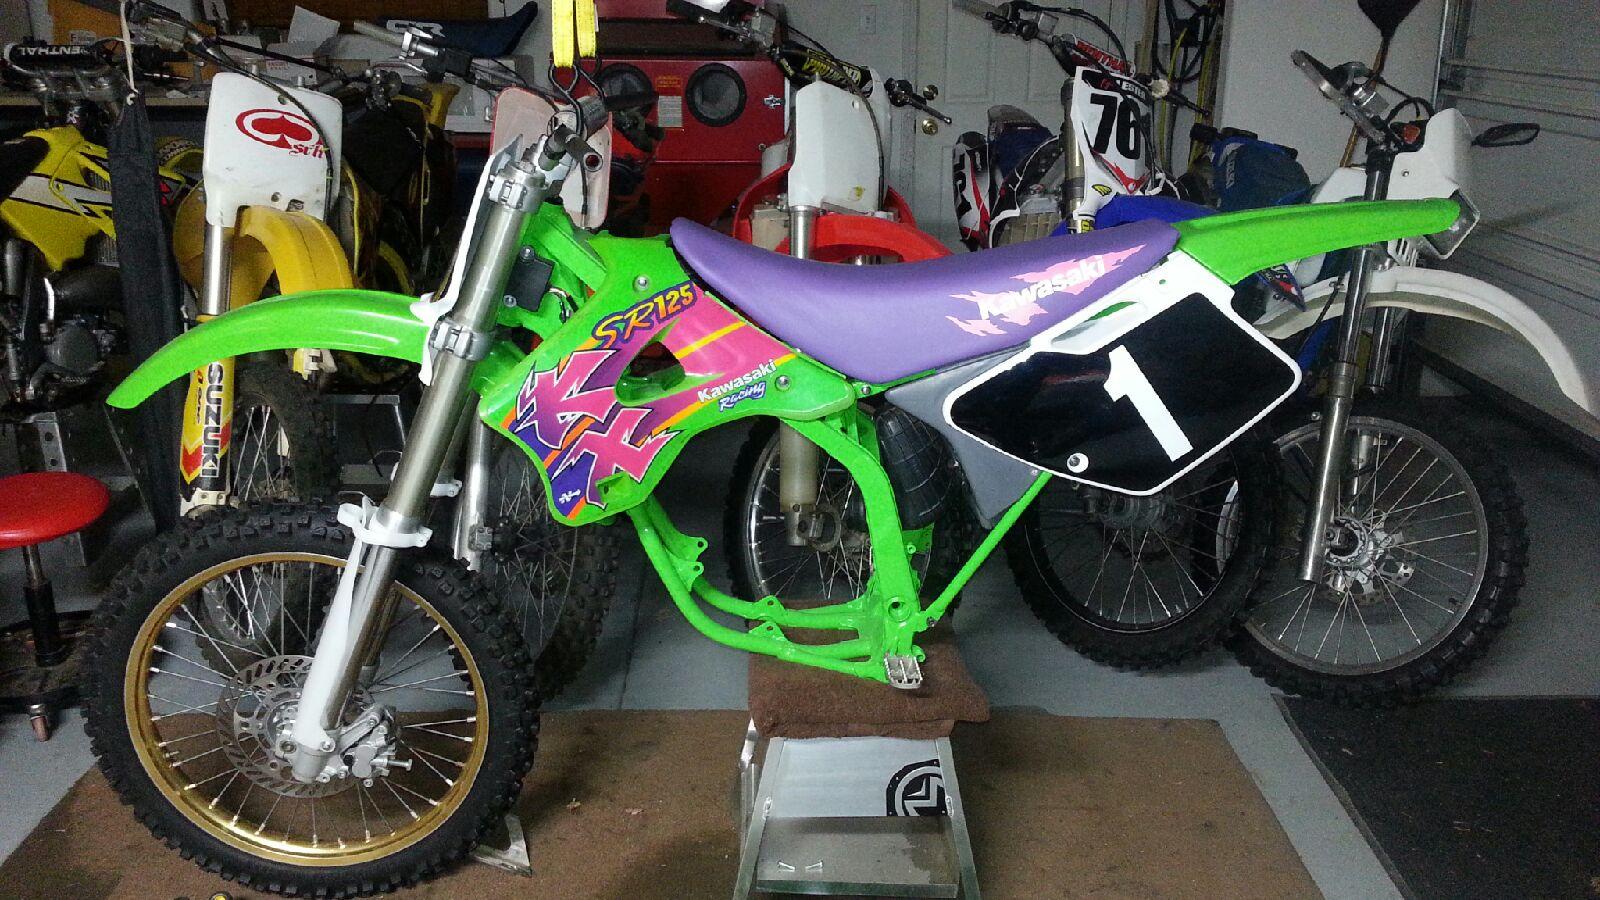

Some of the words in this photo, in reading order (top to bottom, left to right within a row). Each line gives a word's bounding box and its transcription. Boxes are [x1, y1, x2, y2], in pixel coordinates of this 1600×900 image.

[977, 254, 1107, 321] Kawasaki
[200, 361, 224, 477] SUZUKI
[697, 359, 778, 403] Kawasaki
[718, 380, 766, 412] Racing
[1103, 344, 1194, 462] 1
[513, 348, 684, 510] KX
